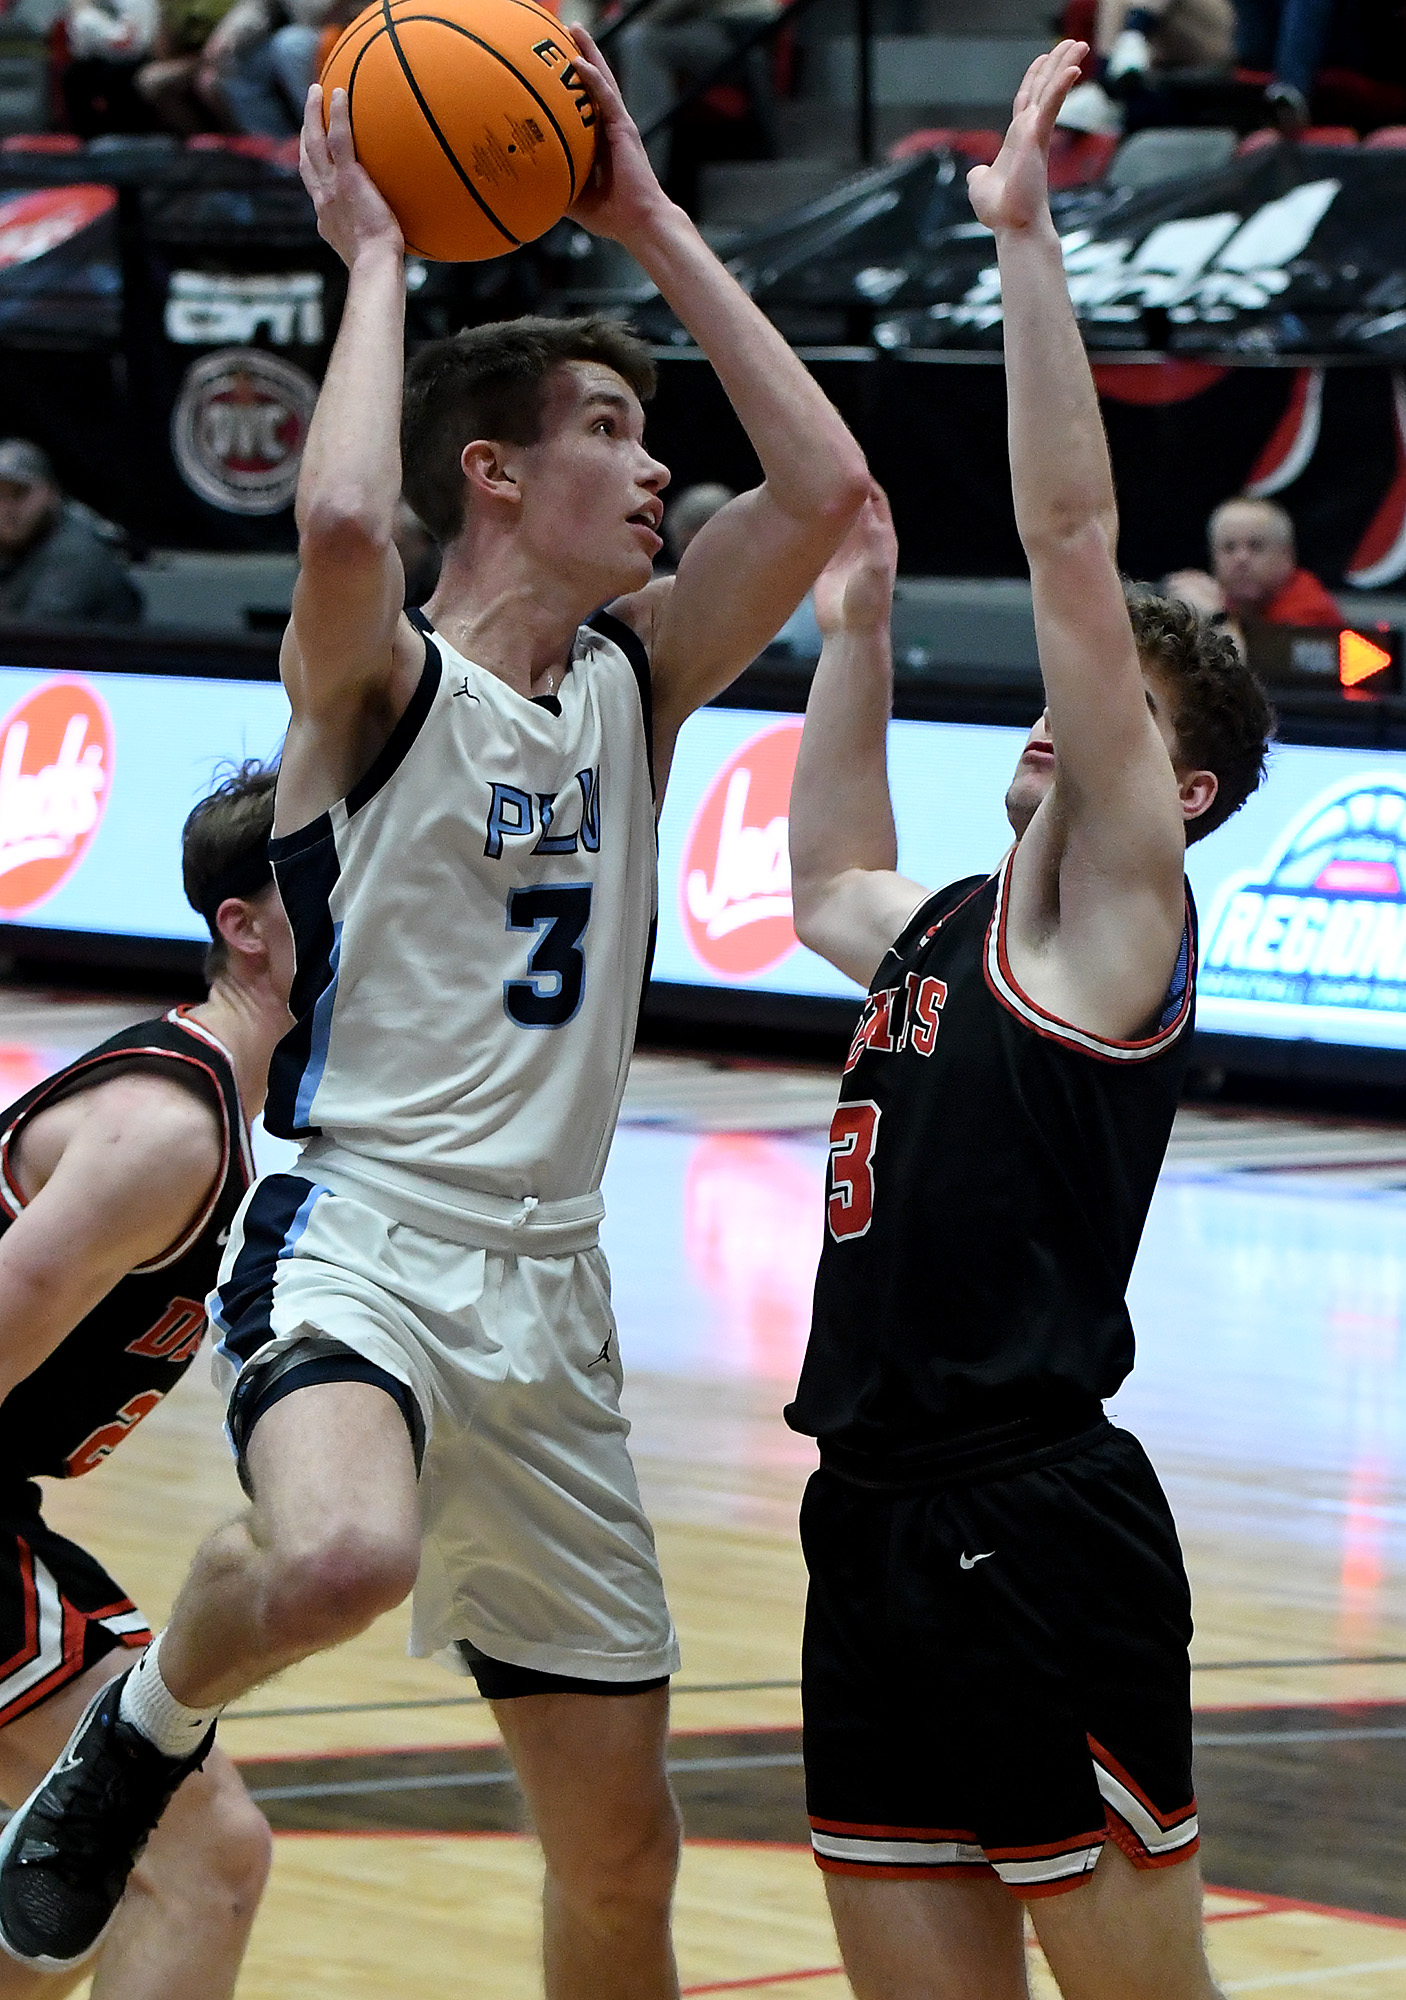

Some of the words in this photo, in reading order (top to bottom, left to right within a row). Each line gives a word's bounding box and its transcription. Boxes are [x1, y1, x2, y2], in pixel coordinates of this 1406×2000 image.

[502, 881, 593, 1030] 3
[1205, 892, 1406, 981] REGION
[828, 1099, 882, 1243] 3
